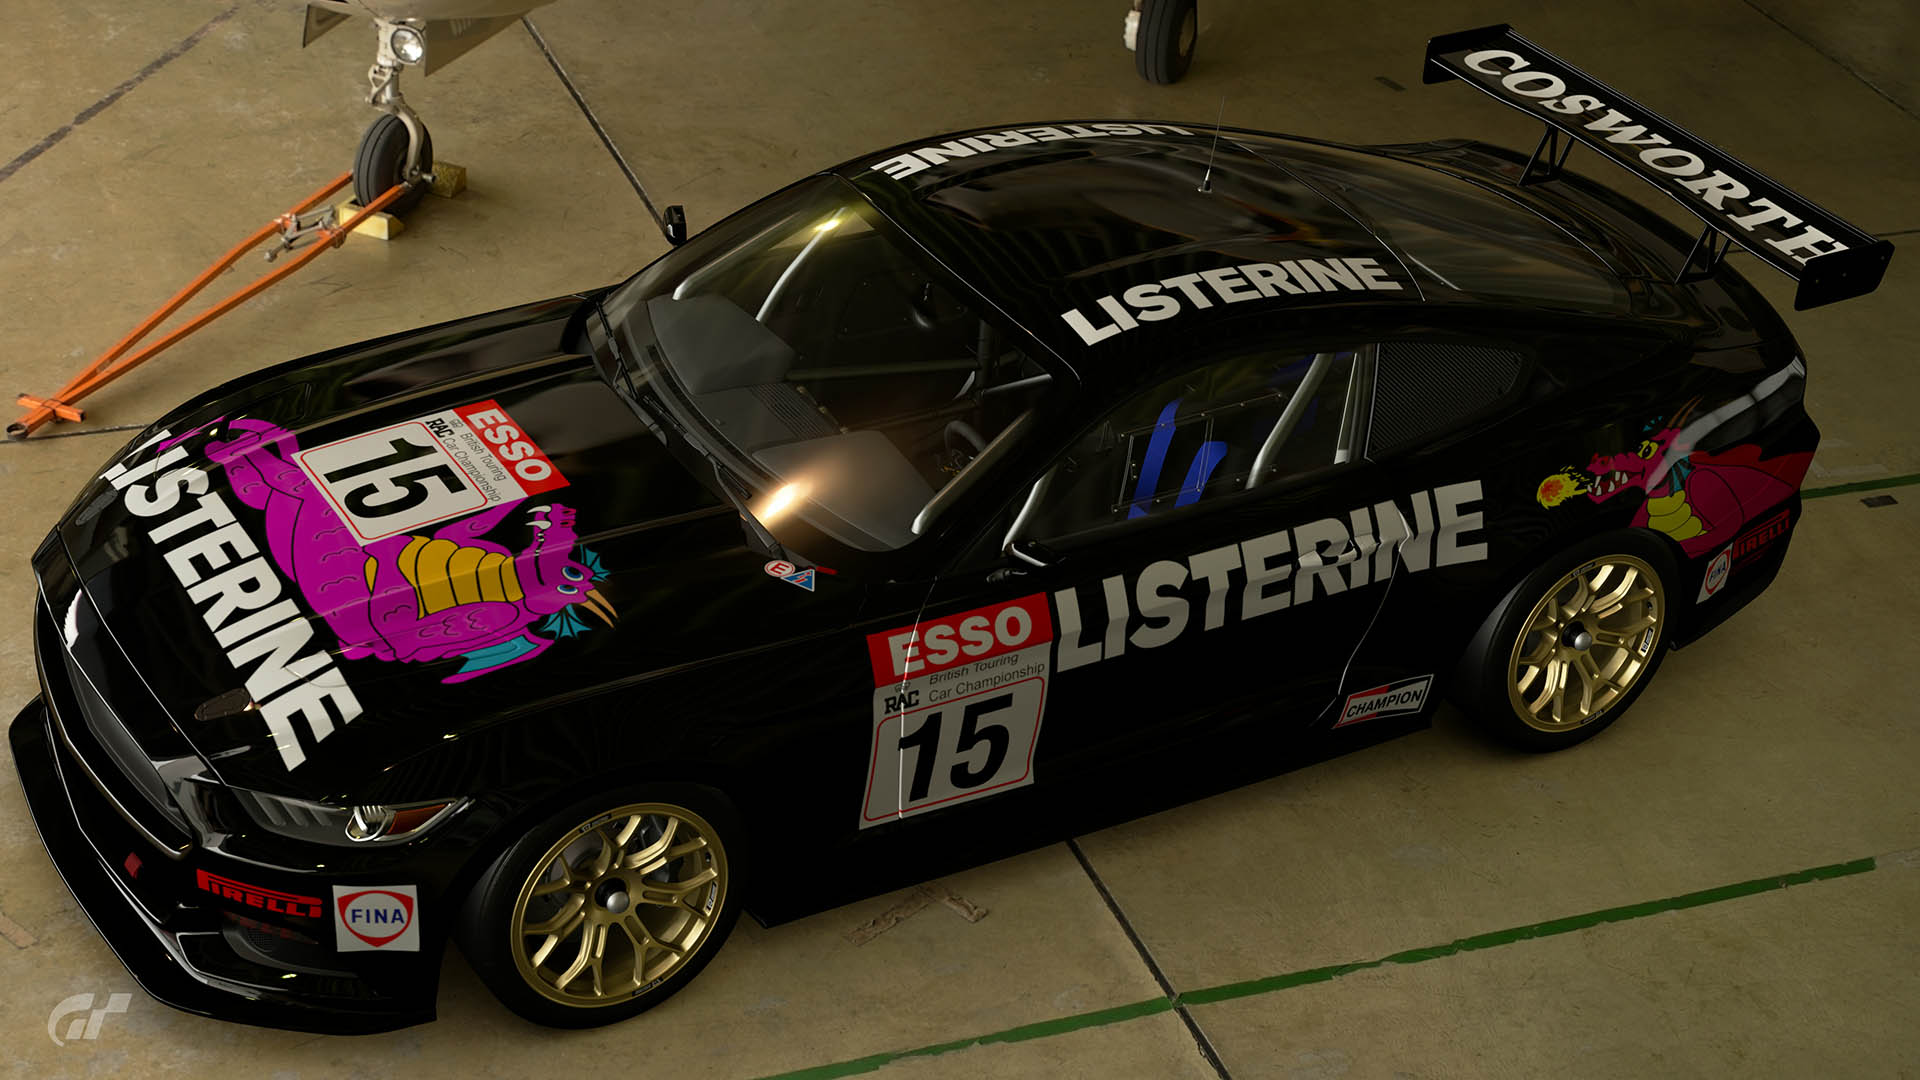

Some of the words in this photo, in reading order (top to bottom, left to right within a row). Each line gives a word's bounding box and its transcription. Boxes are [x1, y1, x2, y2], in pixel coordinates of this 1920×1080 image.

[870, 123, 1195, 181] LISTERINE
[1463, 49, 1850, 266] COSWORTH
[1060, 257, 1403, 346] LISTERINE
[425, 417, 455, 439] RAC
[460, 432, 485, 455] British
[480, 452, 507, 482] Touring
[466, 408, 552, 481] ESSO
[324, 437, 469, 520] 15
[442, 437, 460, 455] Car
[454, 450, 502, 502] Championship
[1733, 508, 1790, 561] PIRELLI
[99, 429, 364, 772] LISTERINE
[1055, 480, 1488, 673] LISTERINE
[888, 606, 1033, 677] ESSO
[929, 666, 969, 686] British
[973, 653, 1019, 673] Touring
[884, 689, 920, 715] RAC
[928, 688, 952, 703] Car
[955, 662, 1046, 696] Championship
[1346, 689, 1423, 718] CHAMPION
[898, 693, 1014, 803] 15
[196, 868, 323, 919] PIRELLI
[351, 908, 406, 925] FINA
